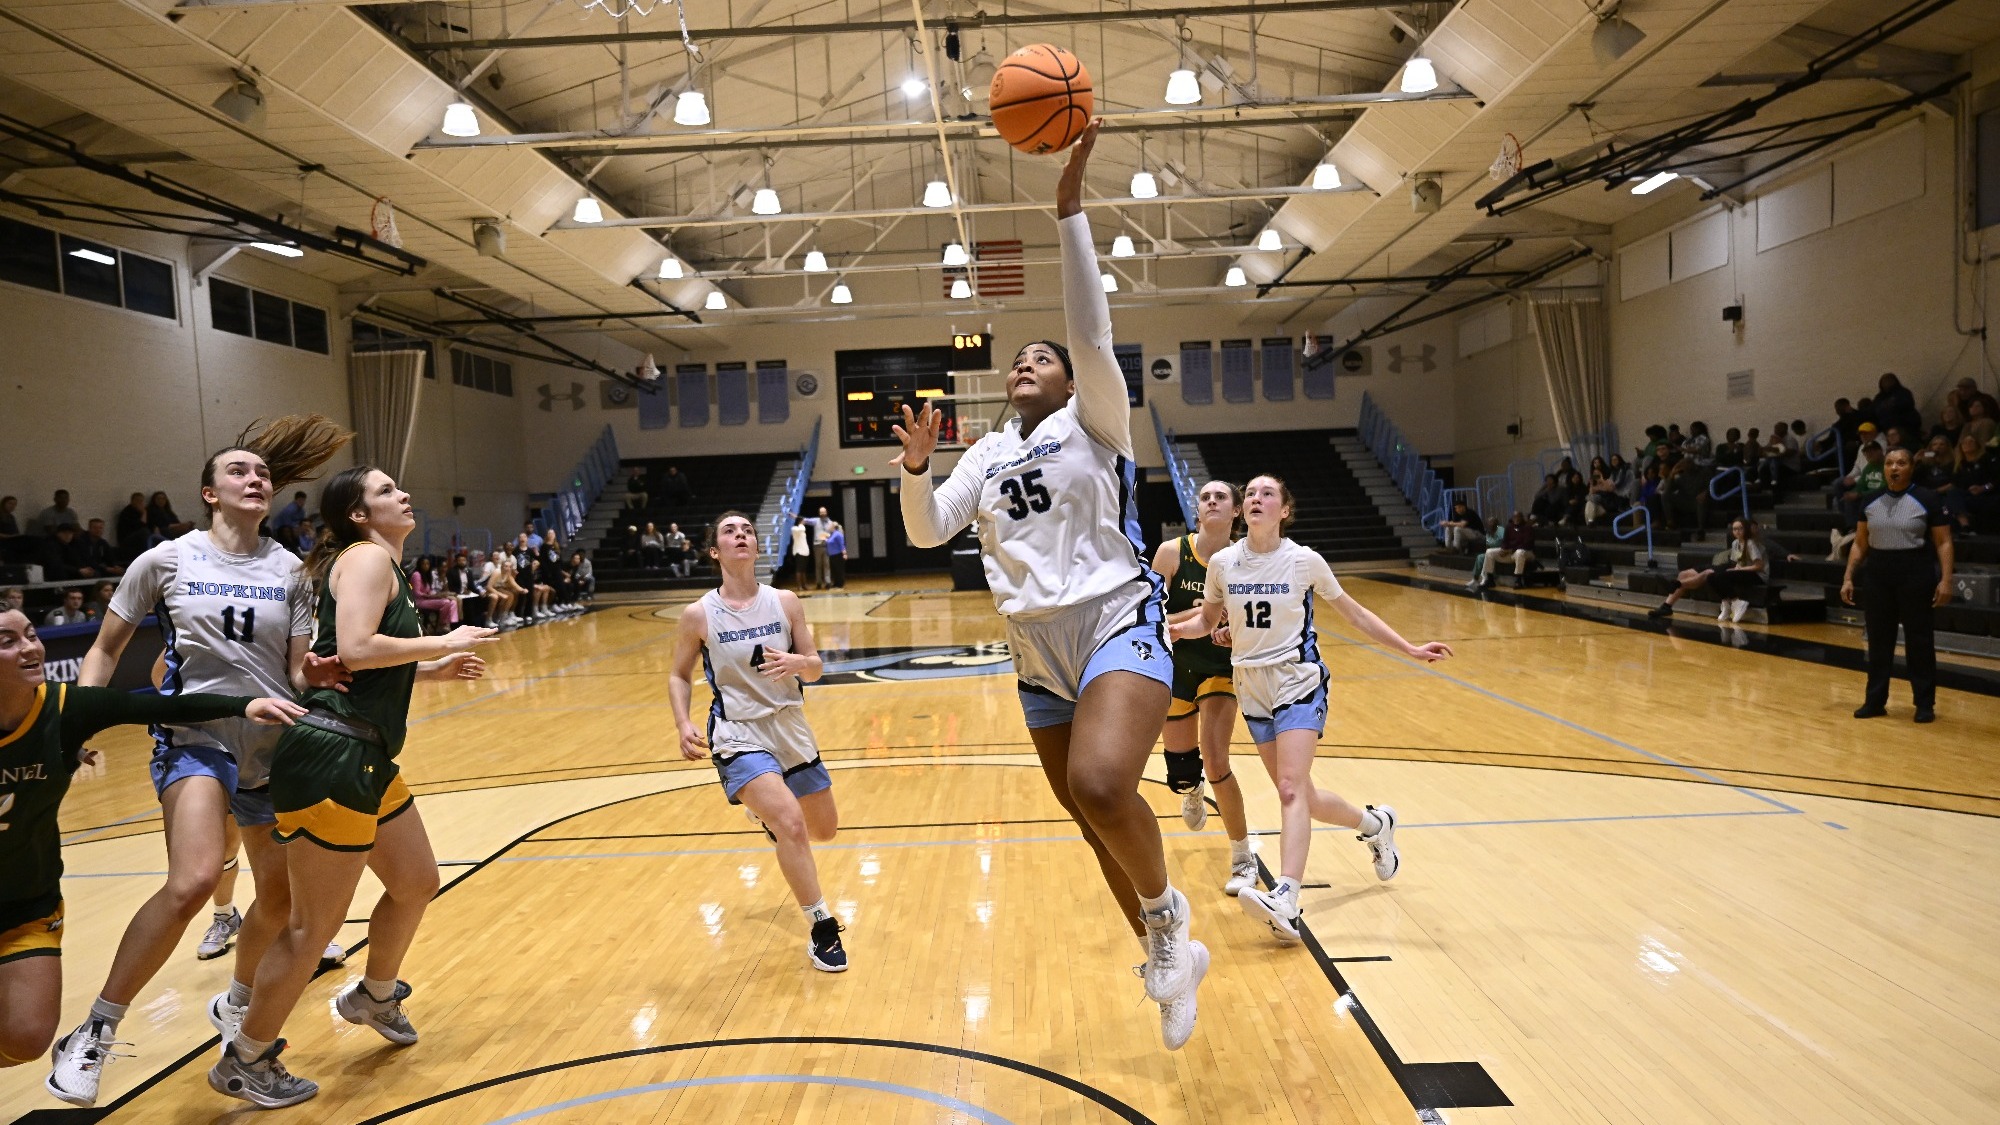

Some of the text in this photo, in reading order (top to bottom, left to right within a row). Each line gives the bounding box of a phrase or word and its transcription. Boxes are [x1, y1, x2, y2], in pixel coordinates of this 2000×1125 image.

[1119, 356, 1141, 371] 019
[1000, 468, 1052, 521] 35
[188, 581, 286, 602] HOPKINS
[1228, 582, 1290, 595] HOPKINS
[221, 605, 255, 643] 11
[1244, 600, 1272, 629] 12
[718, 621, 782, 644] HOPKINS
[44, 656, 83, 683] KIN
[750, 643, 766, 673] 4
